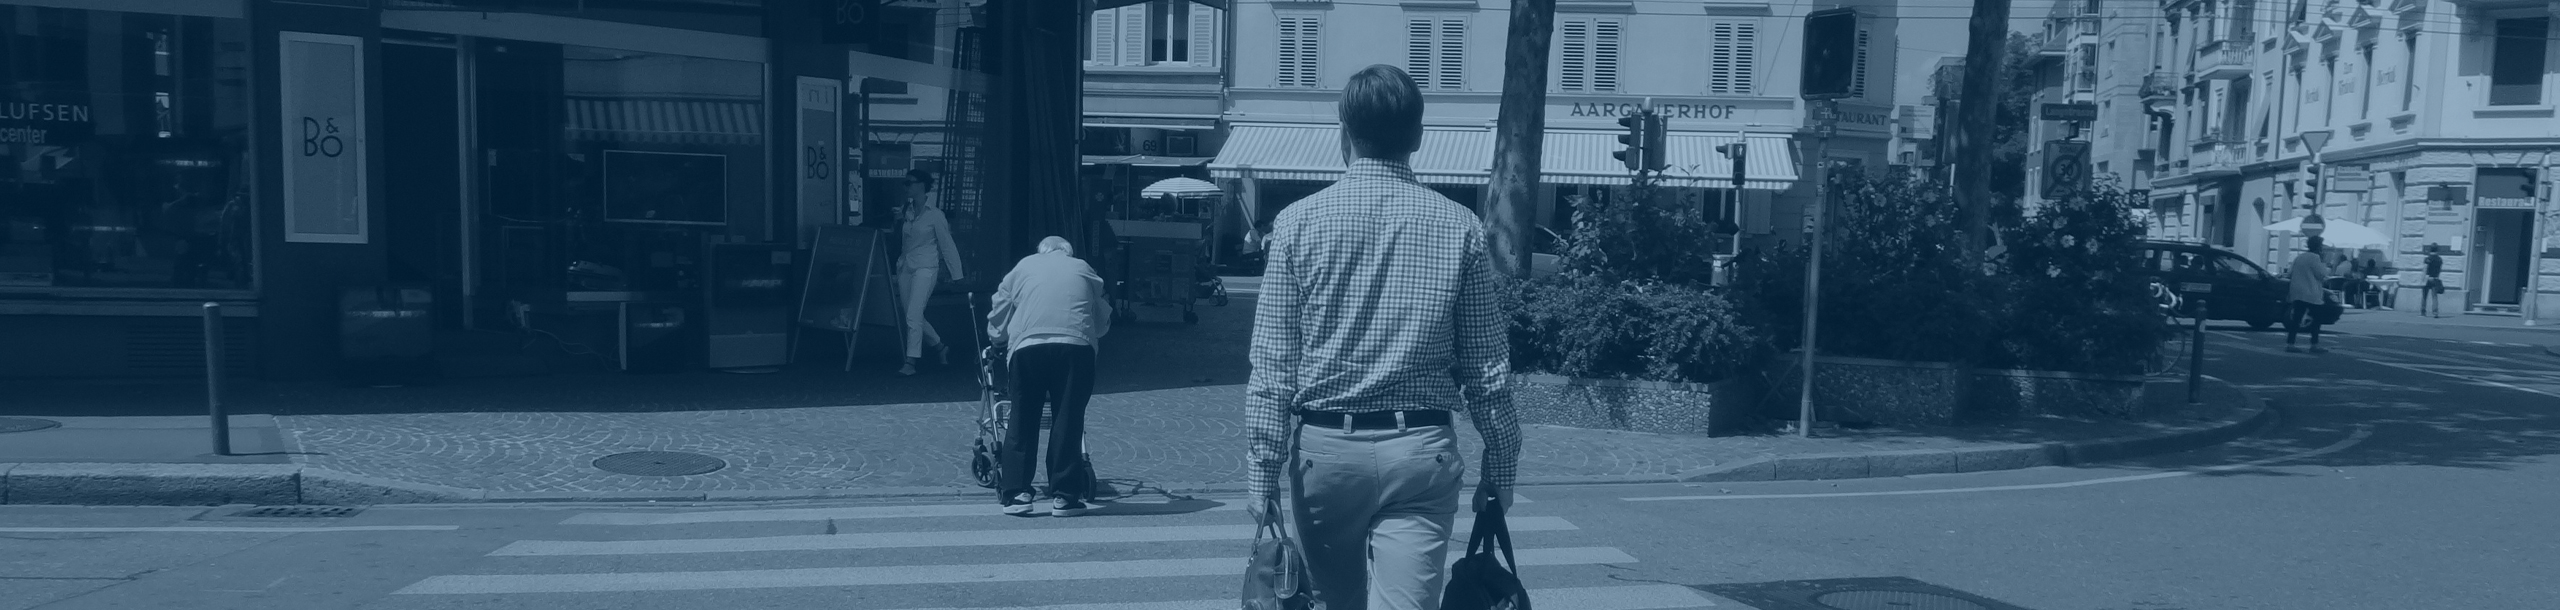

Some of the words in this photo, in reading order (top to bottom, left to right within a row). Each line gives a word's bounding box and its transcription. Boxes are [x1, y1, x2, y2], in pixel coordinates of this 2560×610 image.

[0, 102, 88, 122] LUFSEN
[0, 125, 47, 144] center
[1143, 140, 1156, 151] 69
[2059, 163, 2073, 176] 30
